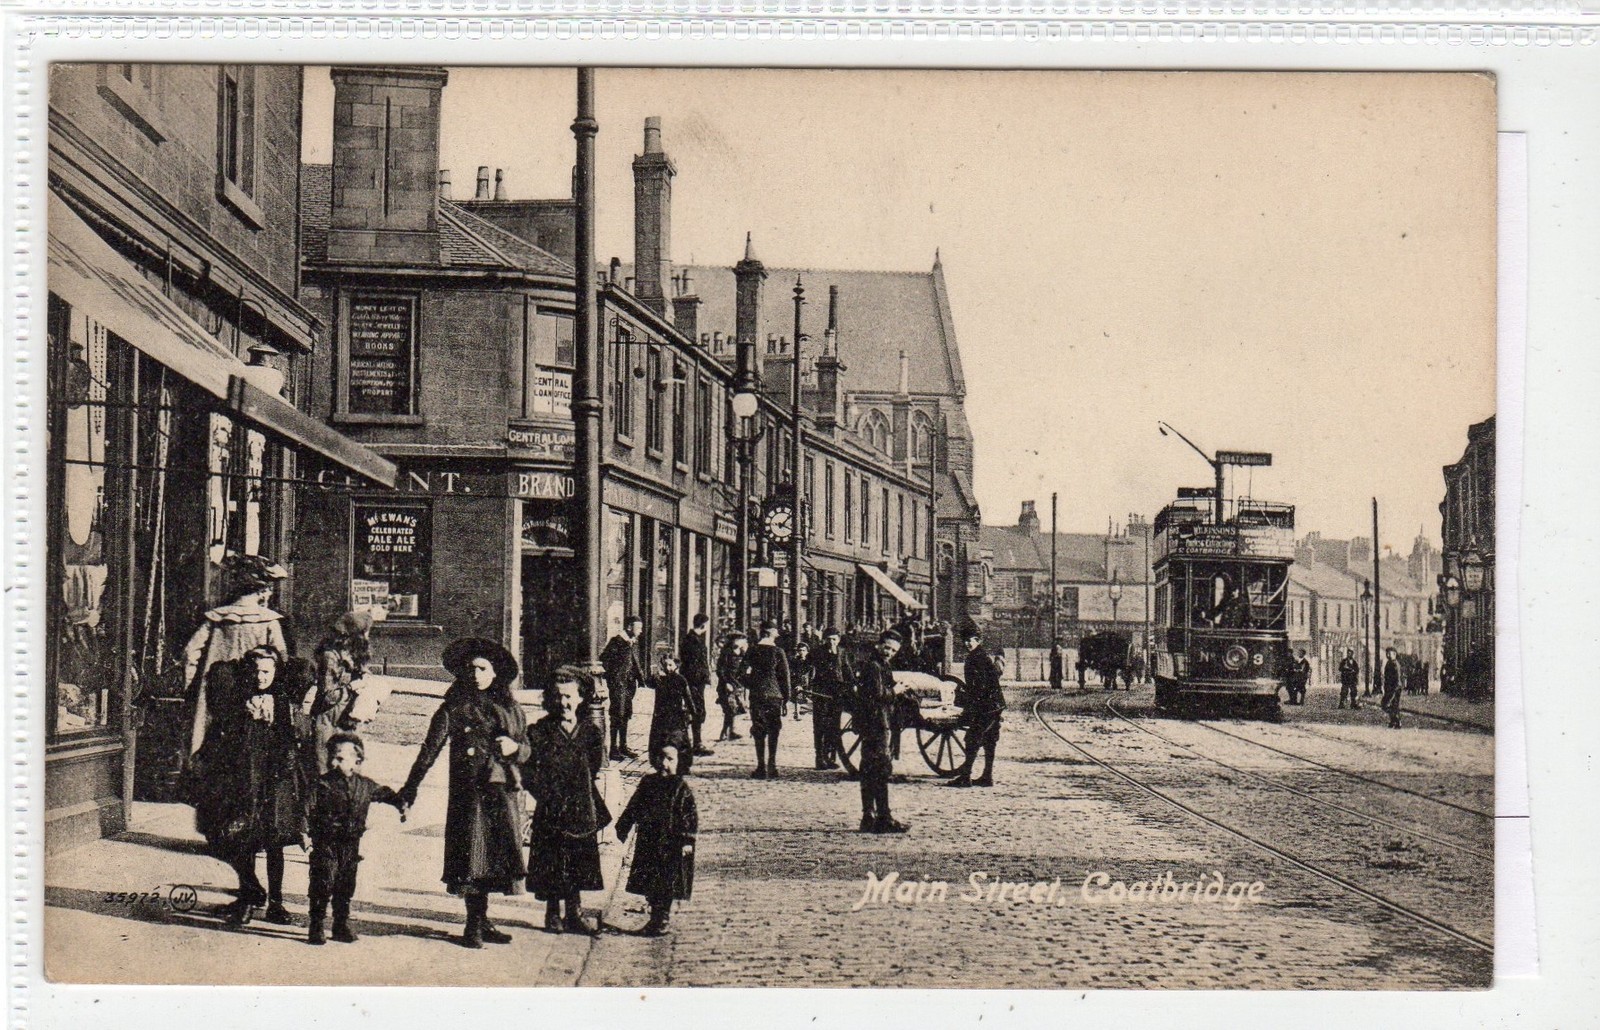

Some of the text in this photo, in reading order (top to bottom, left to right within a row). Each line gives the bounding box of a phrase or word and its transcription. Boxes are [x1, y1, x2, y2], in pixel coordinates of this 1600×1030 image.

[534, 376, 569, 389] CENTRAL
[534, 389, 571, 400] LOAN OFFICE
[518, 473, 575, 498] BRAND
[370, 527, 414, 535] CELEBRATED
[367, 535, 416, 545] PALE ALE
[370, 544, 413, 553] SOLD HERE
